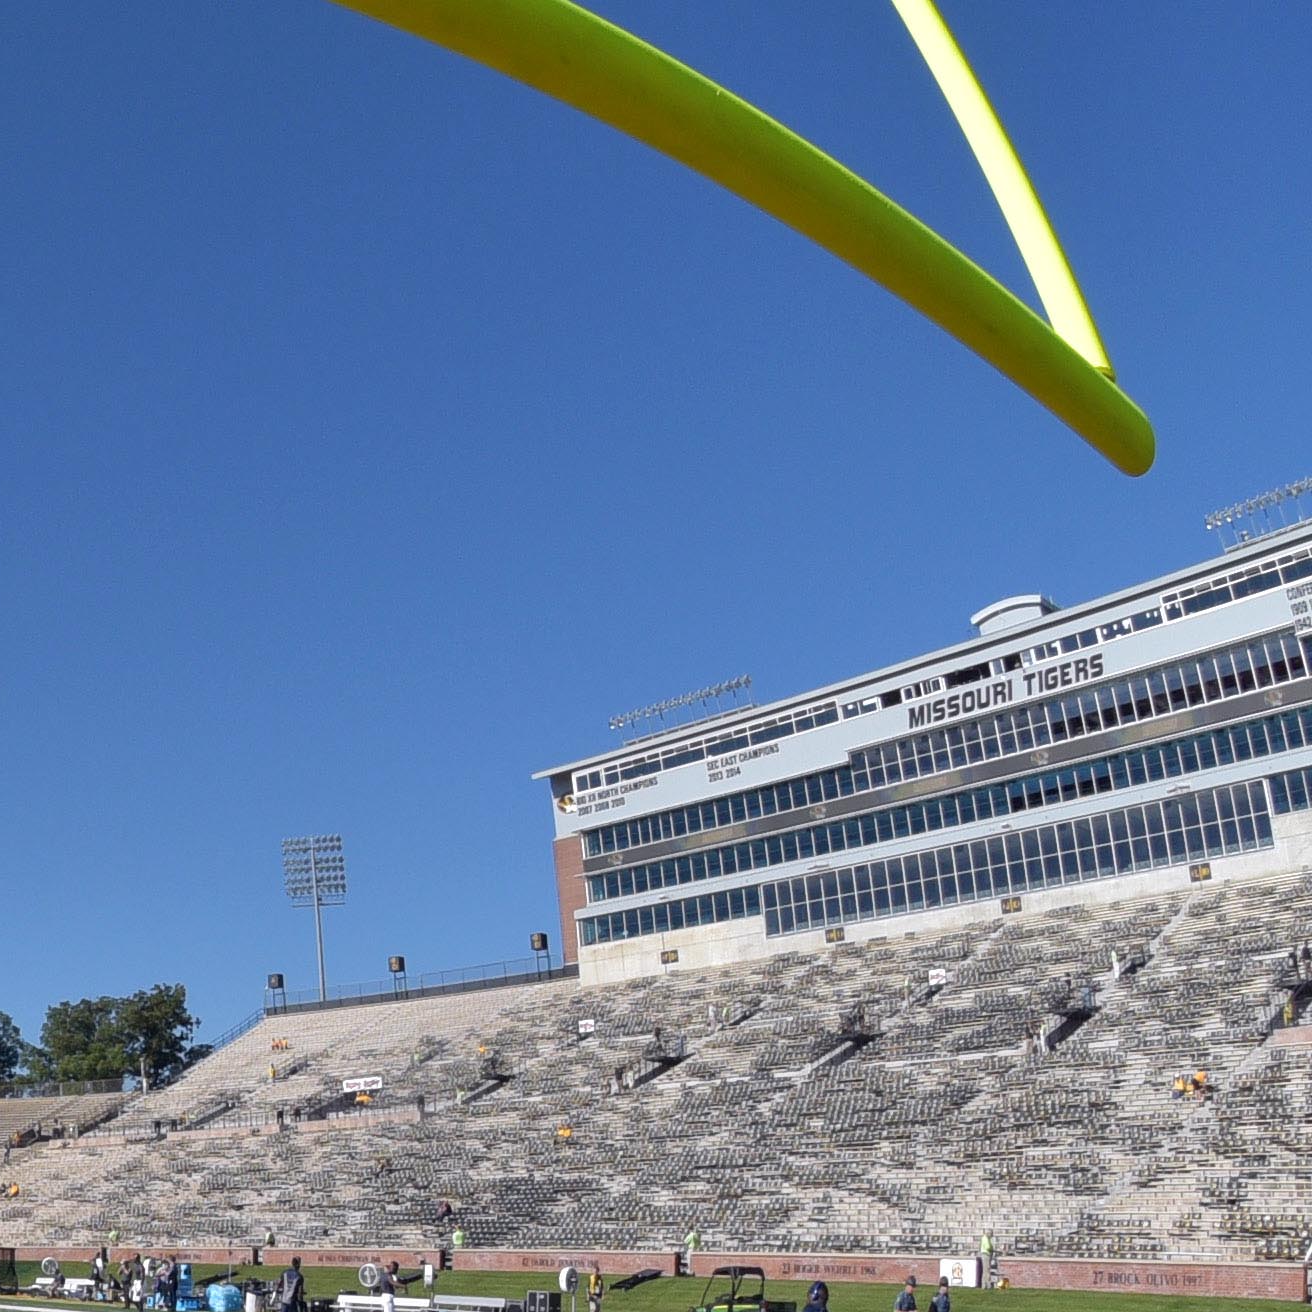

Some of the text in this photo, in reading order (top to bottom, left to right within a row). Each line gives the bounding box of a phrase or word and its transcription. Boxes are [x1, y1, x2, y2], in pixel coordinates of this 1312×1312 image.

[908, 653, 1104, 729] MISSOURI TIGERS
[707, 743, 780, 771] SEC EAST CHAMPIONS
[619, 776, 659, 795] CHAMPIONS
[1092, 1271, 1104, 1285] 27
[1107, 1271, 1140, 1285] BROCK
[1146, 1273, 1179, 1288] OLIVO
